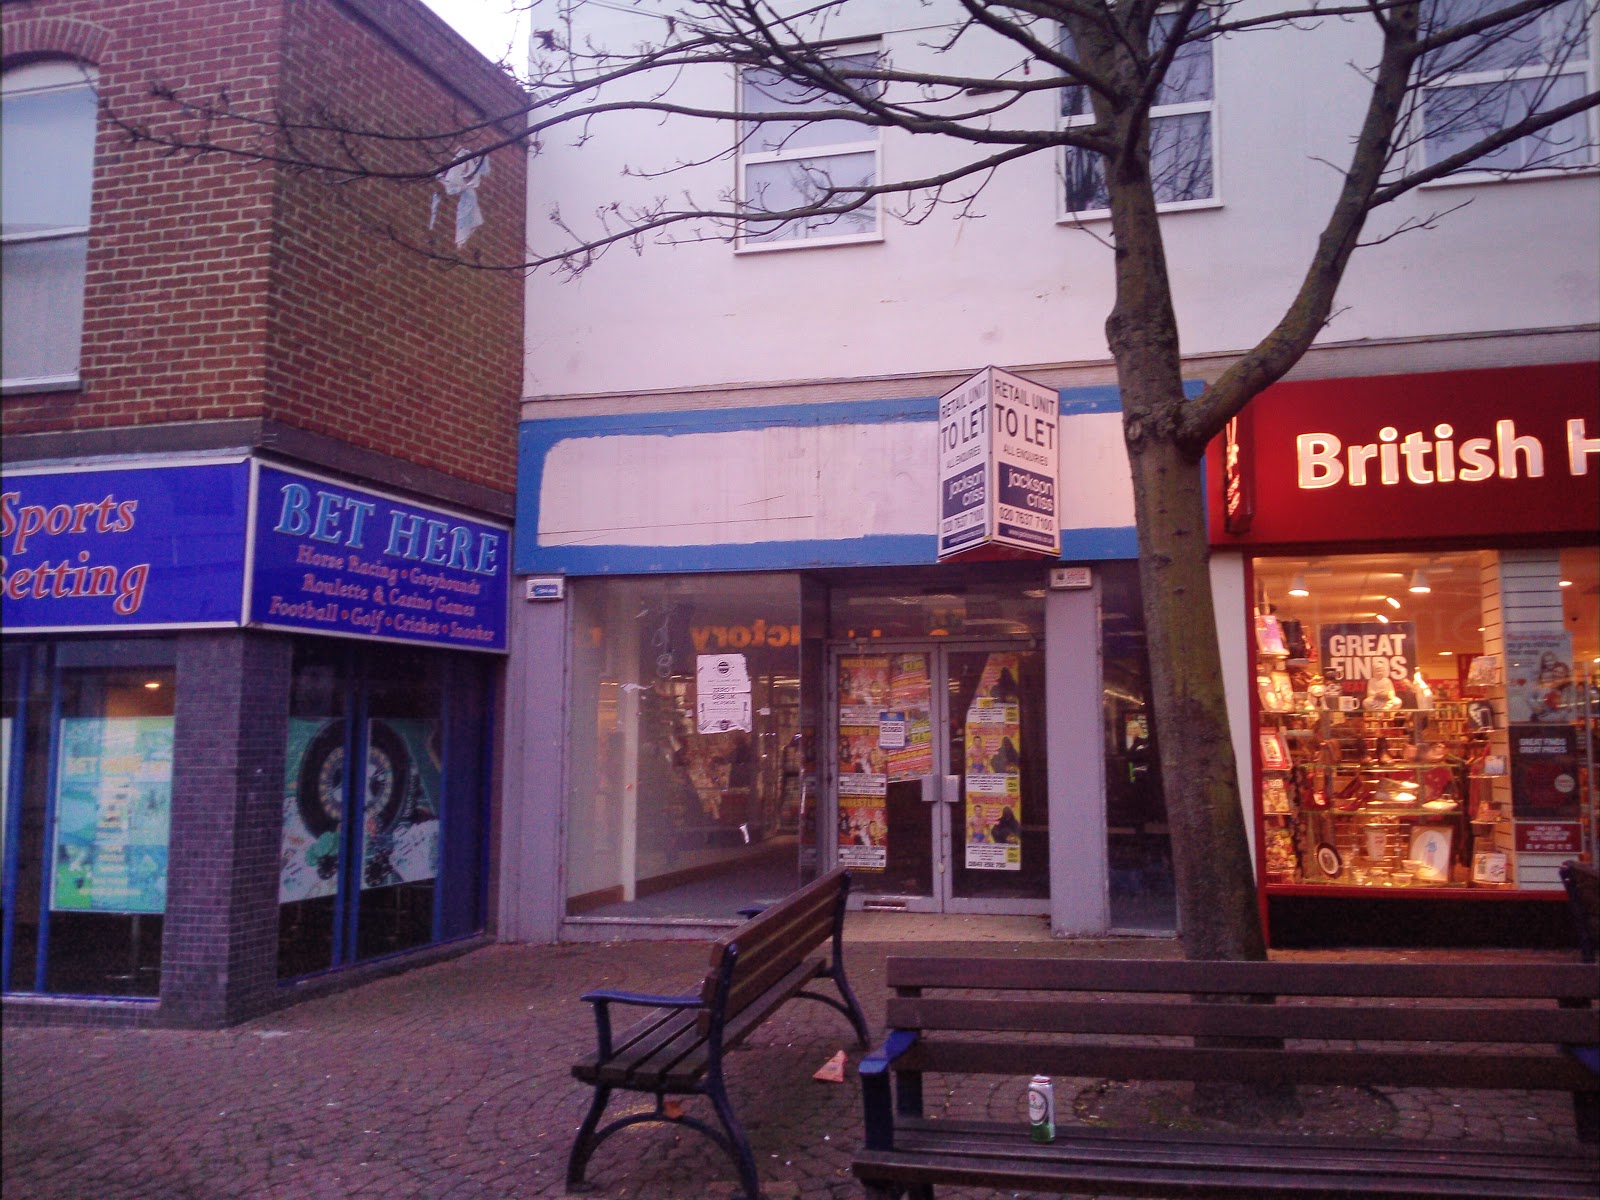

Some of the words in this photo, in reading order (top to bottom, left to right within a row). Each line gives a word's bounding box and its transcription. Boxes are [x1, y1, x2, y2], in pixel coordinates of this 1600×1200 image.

[942, 393, 967, 420] RETAIL
[968, 380, 987, 405] UNIT
[994, 379, 1029, 407] RETAIL
[1032, 393, 1055, 416] UNIT
[941, 422, 958, 454] TO
[962, 404, 987, 444] LET
[995, 403, 1018, 437] TO
[1024, 414, 1055, 450] LET
[1296, 419, 1545, 489] British
[948, 470, 984, 500] jackson
[1008, 469, 1053, 496] jackson
[1026, 493, 1053, 511] criss
[1, 491, 138, 555] Sports
[273, 483, 376, 550] BET
[383, 509, 499, 576] HERE
[296, 544, 344, 570] Horse
[347, 555, 399, 586] Racing
[409, 567, 481, 595] Greyhounds
[302, 573, 369, 601] Roulette
[373, 585, 387, 606] &
[389, 588, 433, 611] Casino
[435, 596, 476, 617] Games
[268, 595, 338, 622] Football
[351, 607, 386, 634] Golf
[393, 613, 441, 635] Cricket
[450, 621, 495, 642] Snooker
[1329, 634, 1407, 657] GREAT
